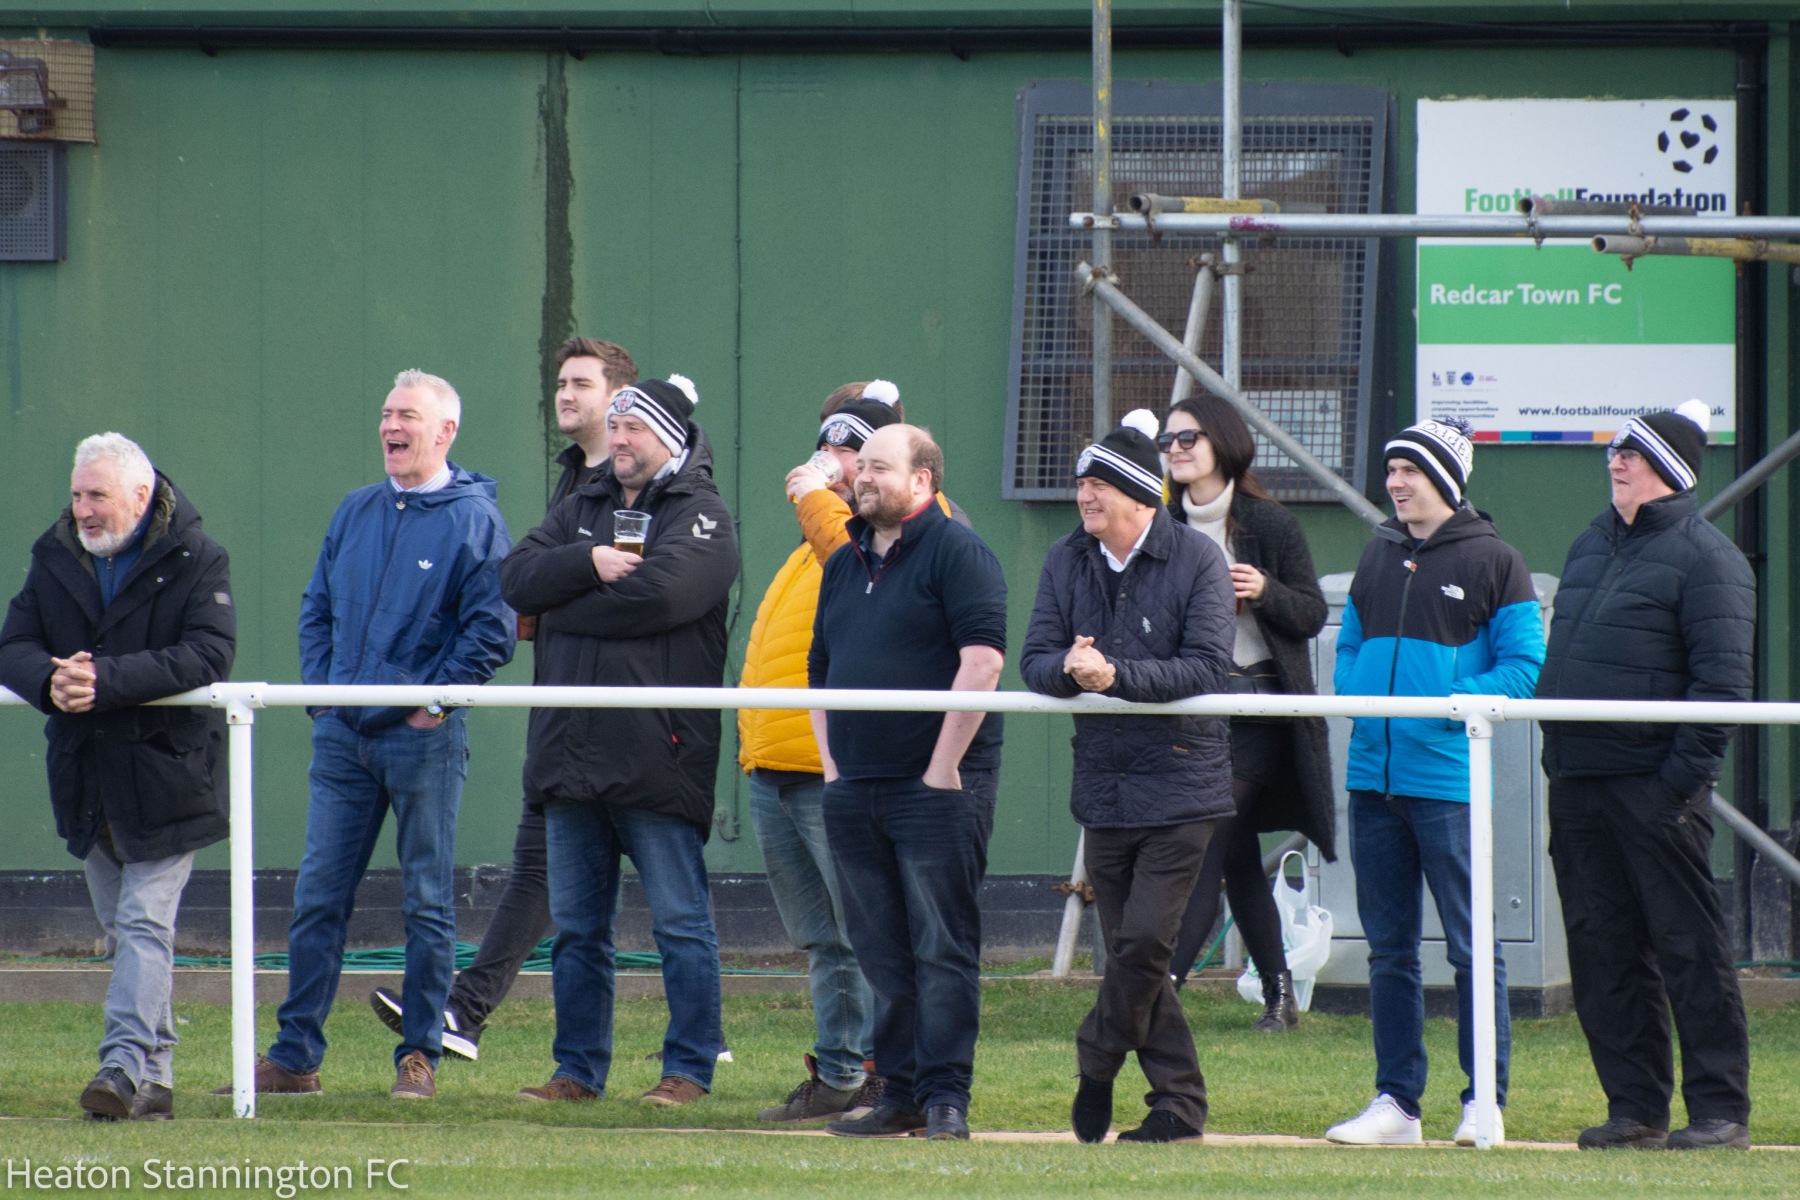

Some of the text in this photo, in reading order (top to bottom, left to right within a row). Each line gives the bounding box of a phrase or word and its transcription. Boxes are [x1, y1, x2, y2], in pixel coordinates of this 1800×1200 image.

[1430, 283, 1622, 304] Redcar Town FC
